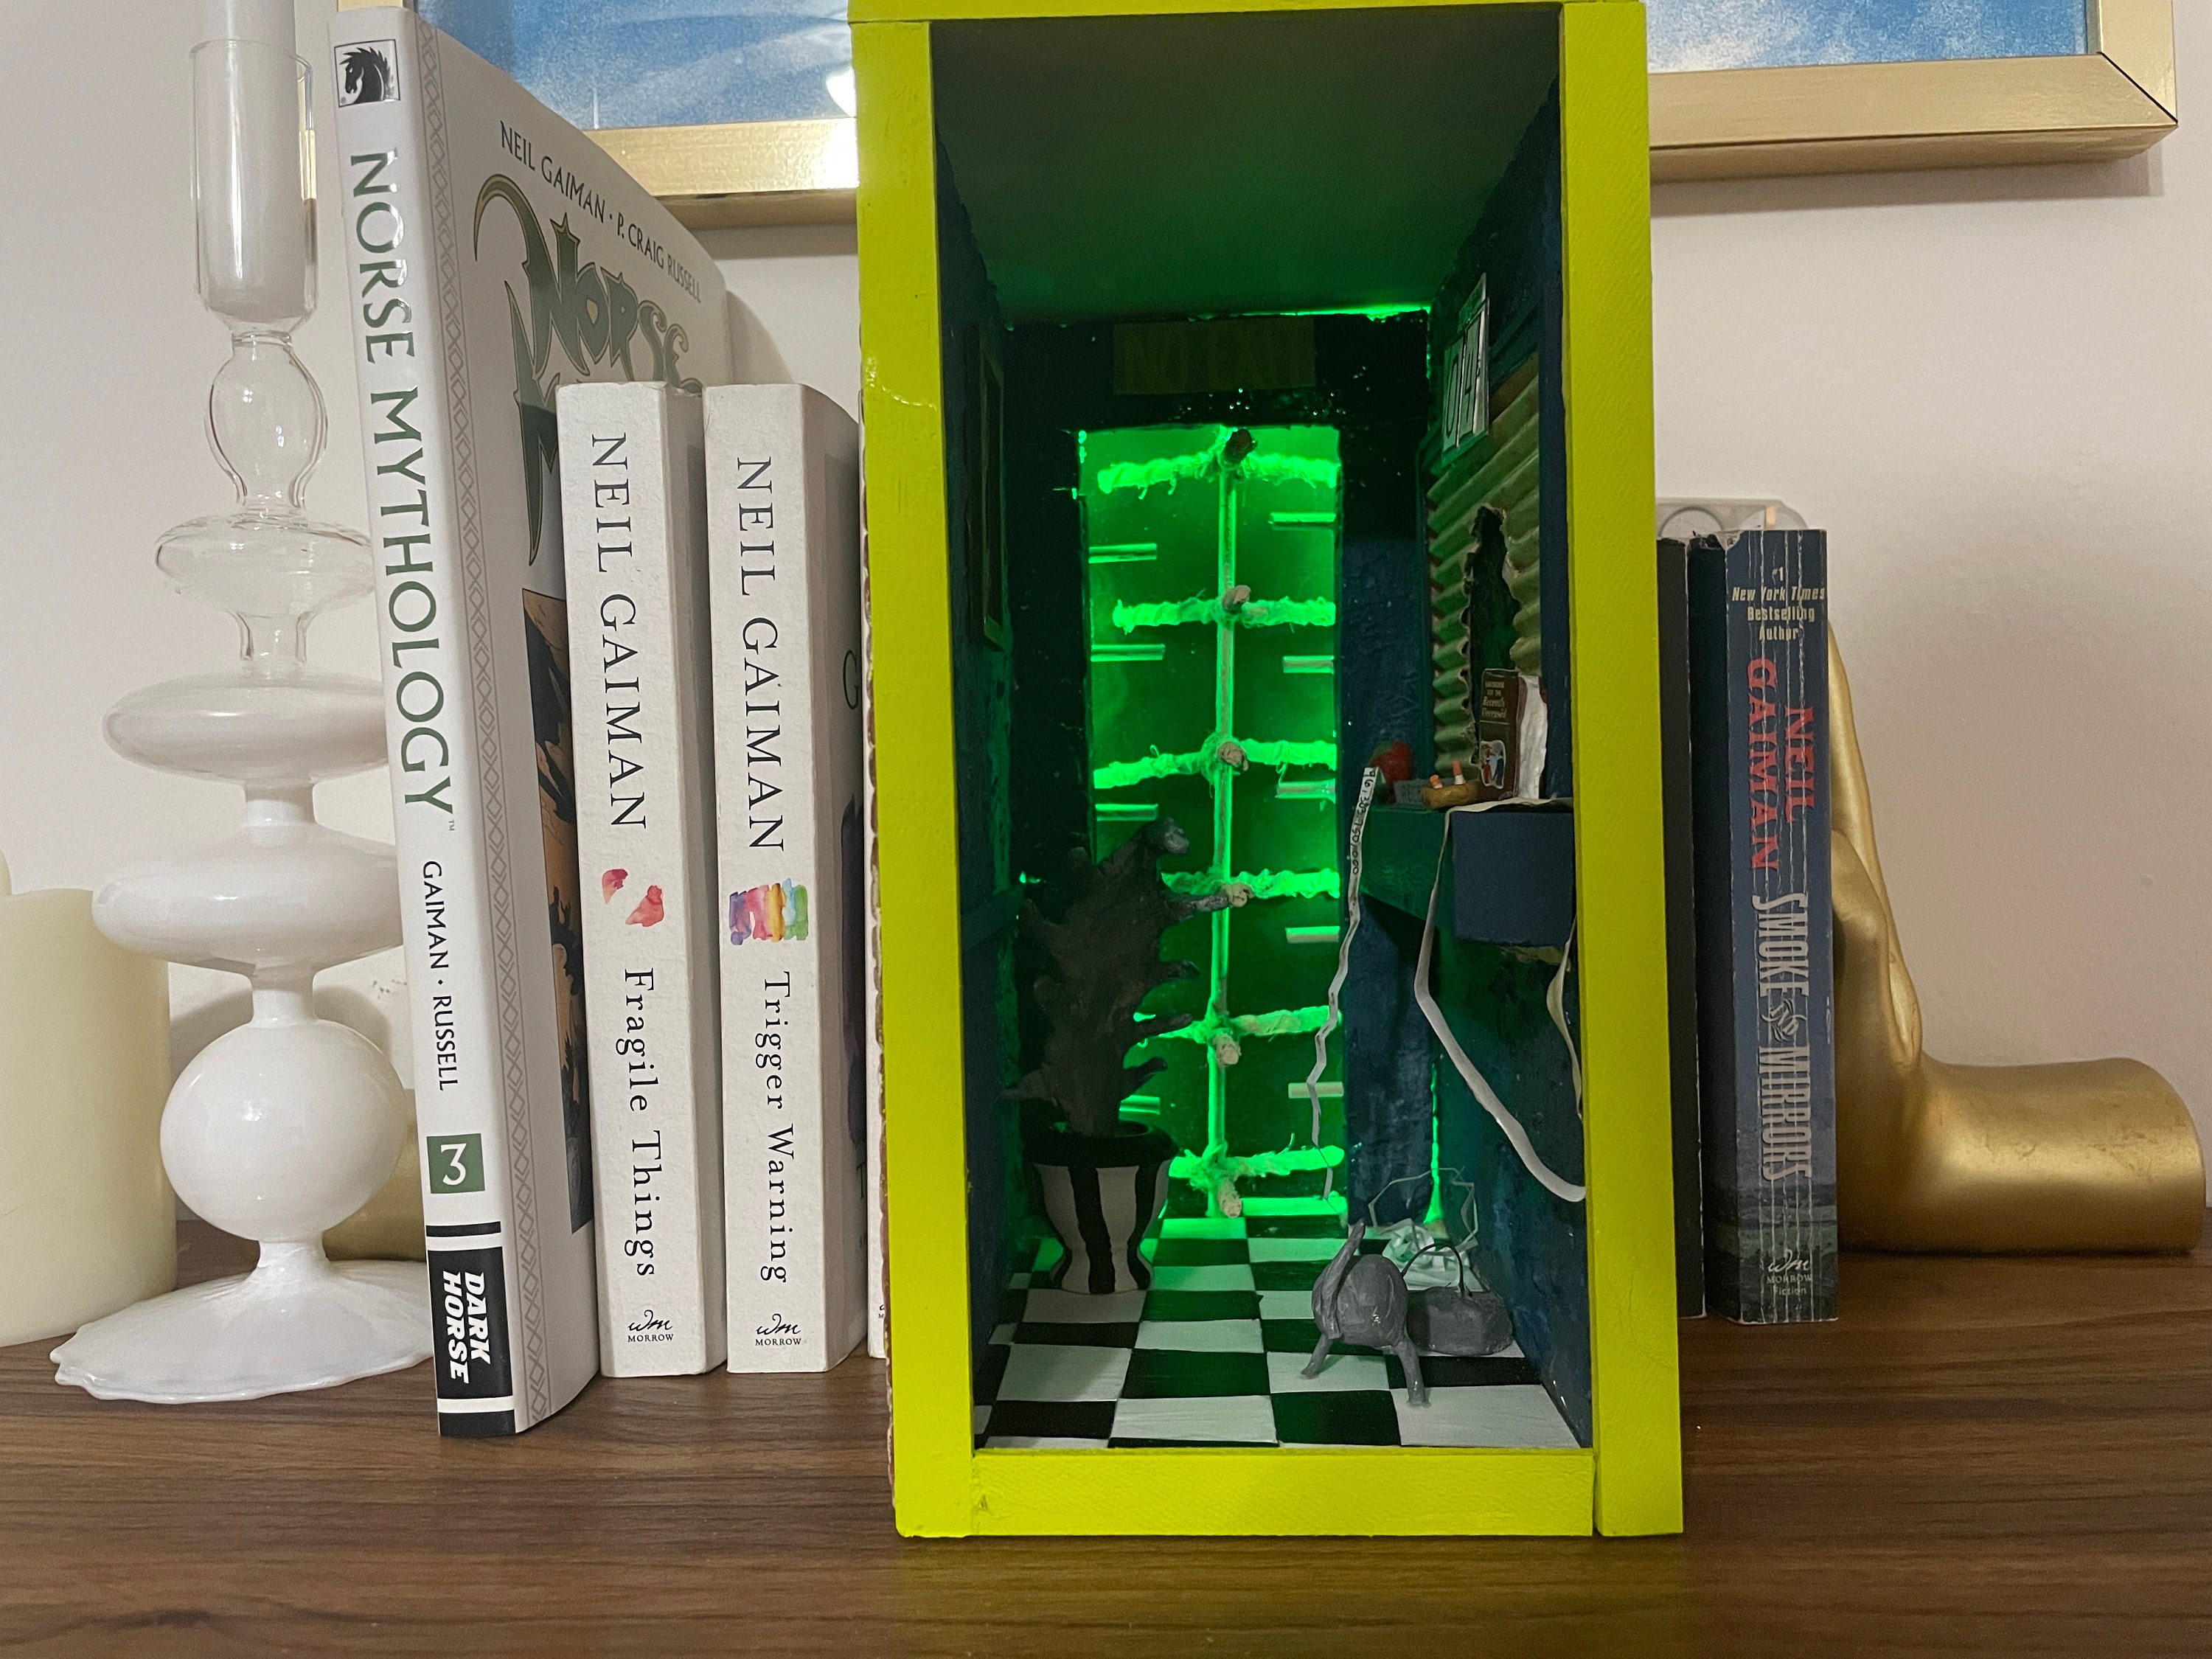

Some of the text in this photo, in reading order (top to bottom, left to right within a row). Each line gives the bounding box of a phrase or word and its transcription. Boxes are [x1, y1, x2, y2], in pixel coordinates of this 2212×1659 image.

[349, 147, 414, 364] NORSE
[500, 120, 701, 304] NEIL GAIMAN P. CRAIG RUSSELL
[370, 387, 453, 815] MYTHOLOGY
[592, 433, 647, 829] NEIL GAIMAN
[1732, 586, 1826, 601] New York Times
[1747, 606, 1815, 622] Bestselling
[1759, 625, 1799, 640] Author
[737, 456, 785, 852] NEIL GAIMAN
[1747, 658, 1778, 870] GAIMAN
[1784, 705, 1814, 823] NEIL
[422, 860, 459, 1091] GAIMAN RUSSELL
[1752, 893, 1809, 998] SMOKE
[441, 1142, 467, 1186] 3
[616, 968, 662, 1276] Fragile Things
[756, 970, 795, 1283] Trigger Warning
[1759, 1046, 1812, 1181] MIRRORS
[442, 1270, 469, 1383] HORSE
[462, 1272, 491, 1364] DARK
[627, 1333, 674, 1342] MORROW
[1767, 1273, 1813, 1284] MORROW
[755, 1338, 801, 1346] MORROW
